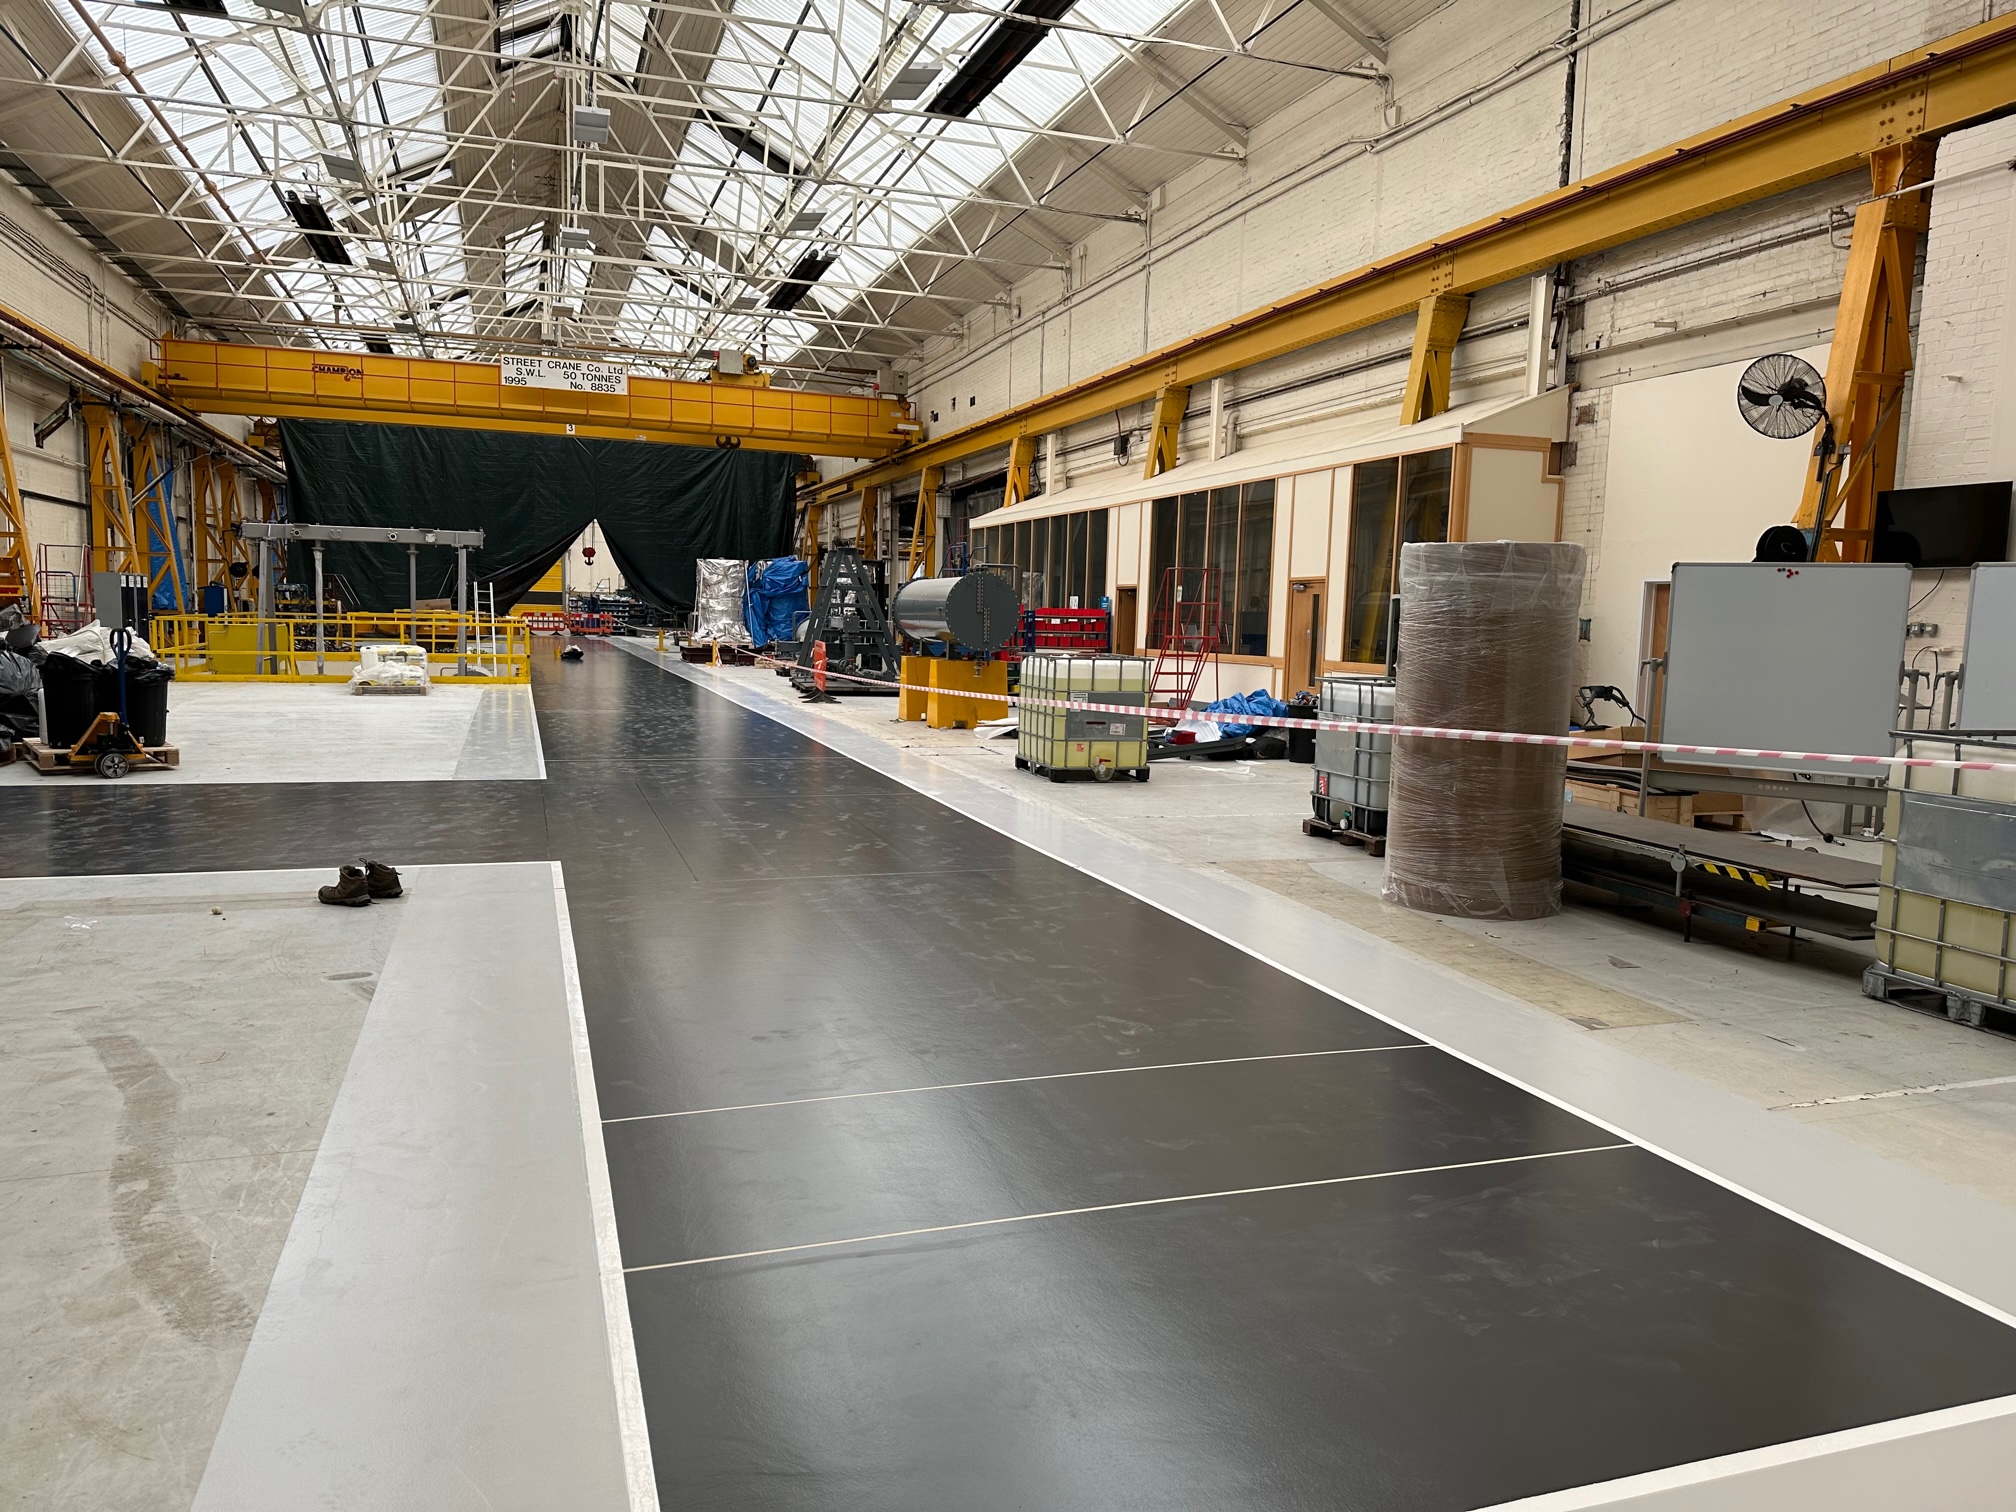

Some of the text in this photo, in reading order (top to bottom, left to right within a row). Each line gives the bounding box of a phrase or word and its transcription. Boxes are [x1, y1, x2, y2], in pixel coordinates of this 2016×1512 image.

[503, 357, 626, 375] STREET CRANE Co. Ltd.
[515, 368, 621, 384] S.W.L. 50 TONNES
[503, 376, 616, 393] 1995 No. 8835
[568, 424, 574, 432] 3
